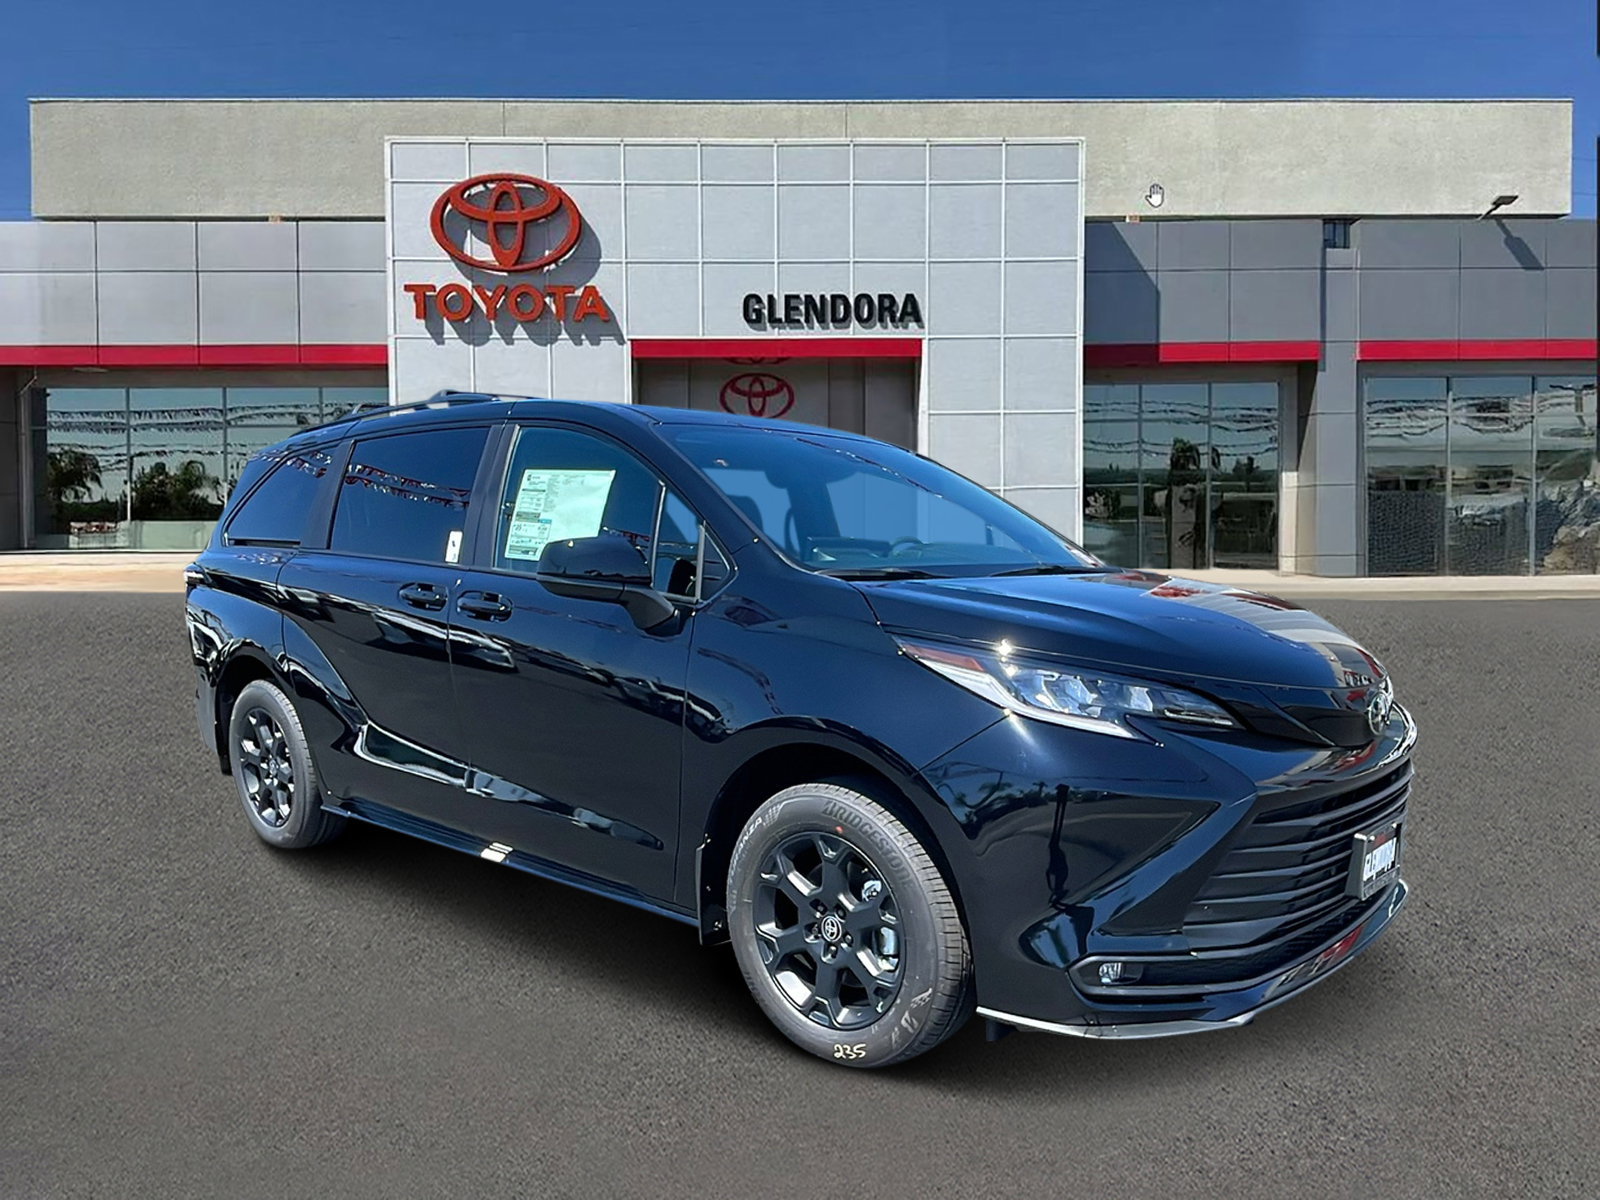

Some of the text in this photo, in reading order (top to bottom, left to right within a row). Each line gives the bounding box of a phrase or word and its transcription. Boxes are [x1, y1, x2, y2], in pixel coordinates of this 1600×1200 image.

[404, 283, 610, 322] TOYOTA
[743, 293, 922, 325] GLENDORA
[833, 1043, 867, 1059] 235
